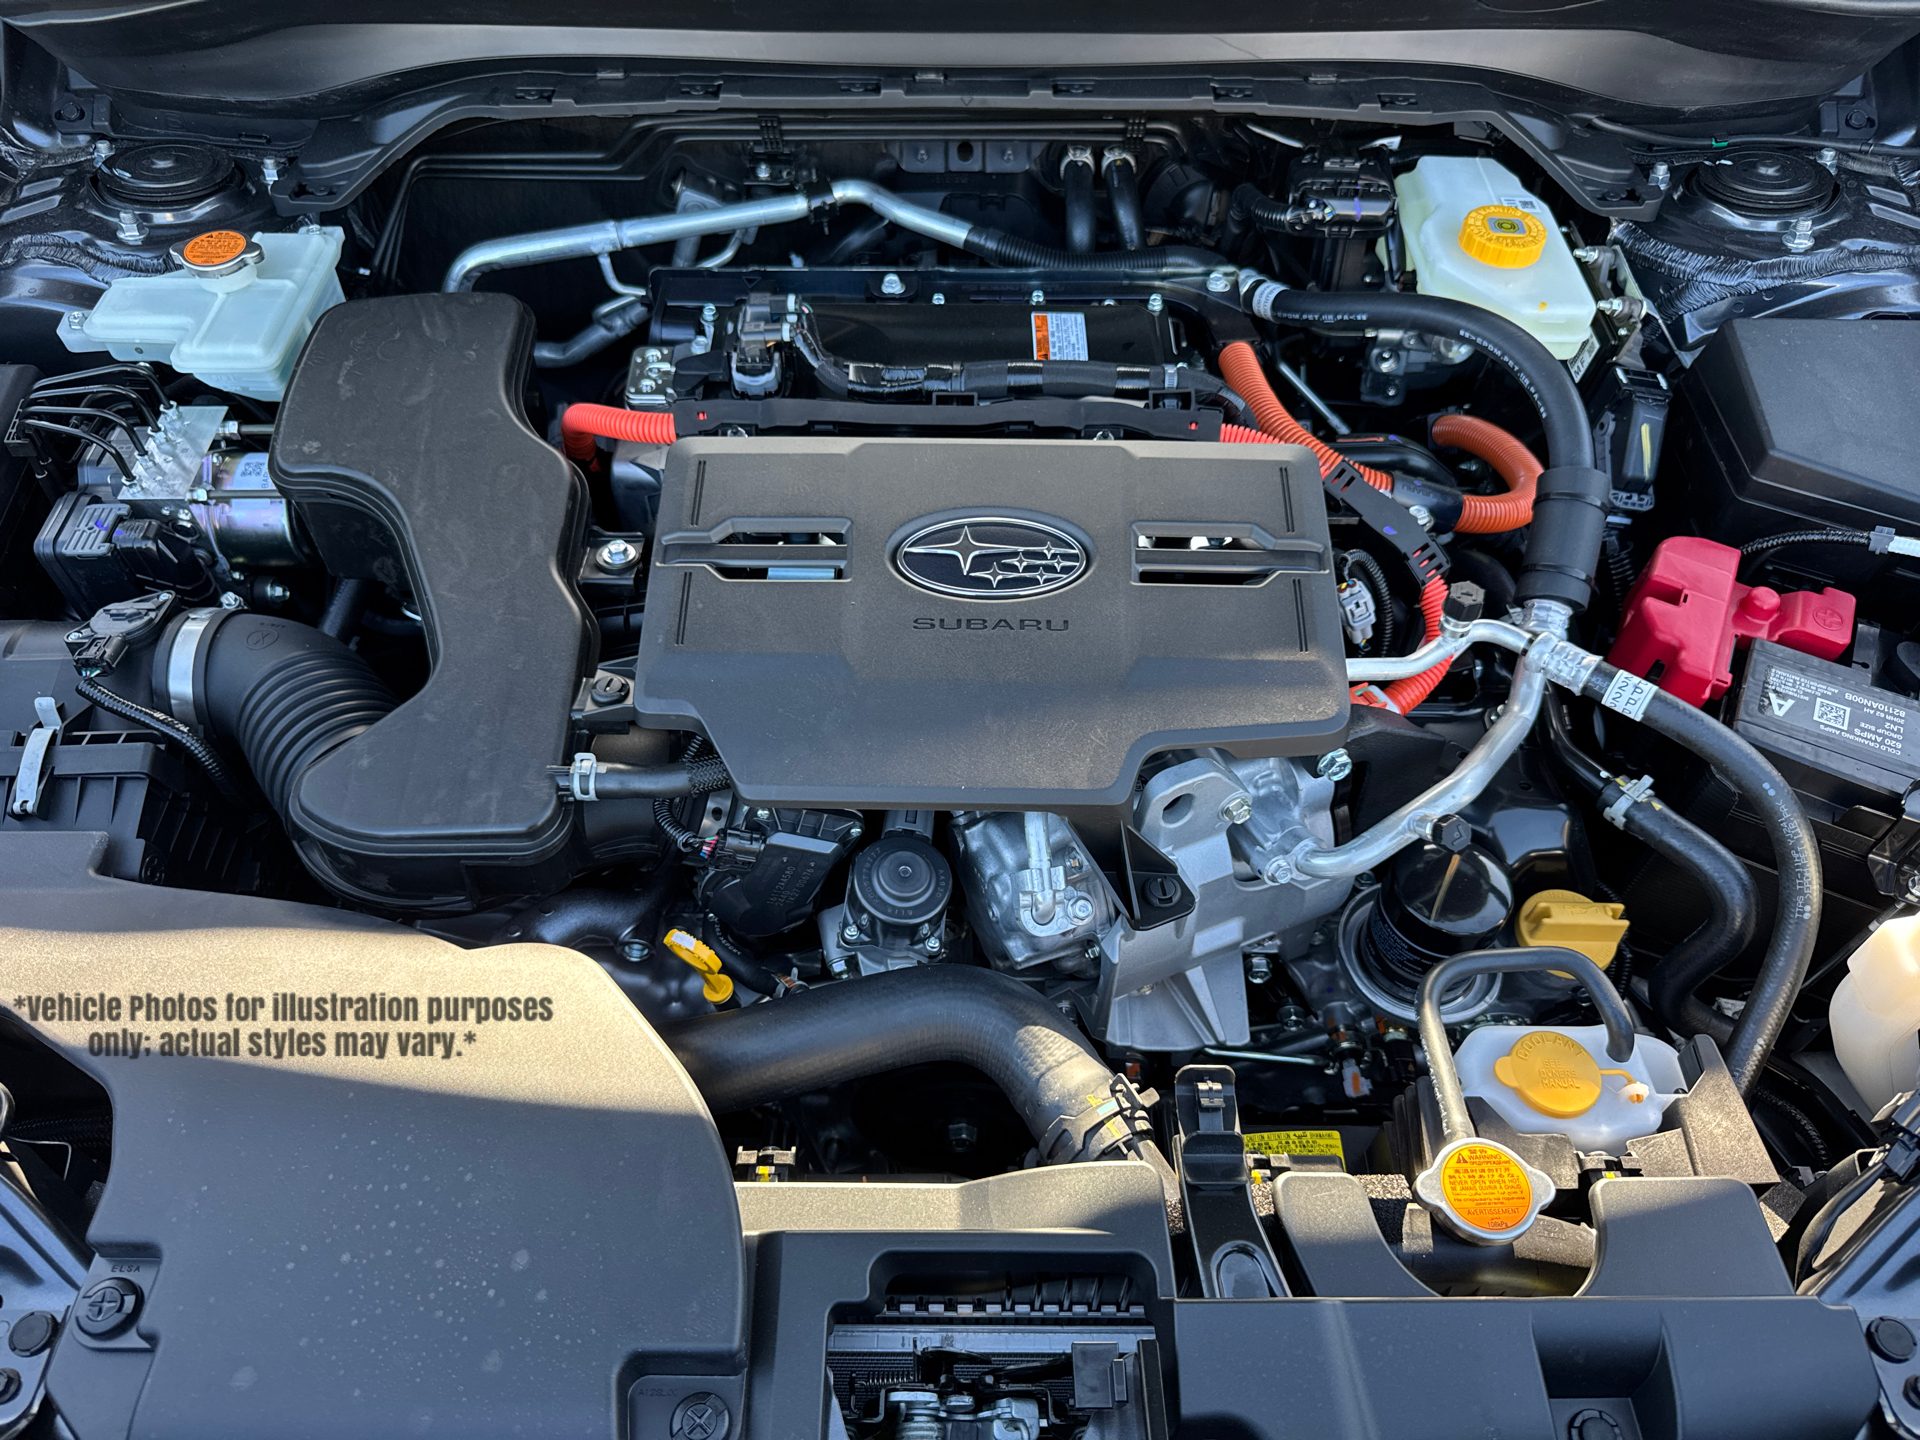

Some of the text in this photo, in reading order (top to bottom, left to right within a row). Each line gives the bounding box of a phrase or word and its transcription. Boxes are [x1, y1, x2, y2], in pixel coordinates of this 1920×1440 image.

[912, 618, 1069, 631] SUBARU
[1860, 722, 1903, 740] GROUP SIZE
[1885, 722, 1904, 733] LN2
[1820, 725, 1901, 755] COLD CRANKING AMPS
[1854, 728, 1902, 749] 620 AMPS
[1516, 1034, 1587, 1060] COOLANT
[1543, 1060, 1561, 1068] SEE
[1539, 1069, 1577, 1078] OWNERS
[1542, 1078, 1580, 1089] MANUAL
